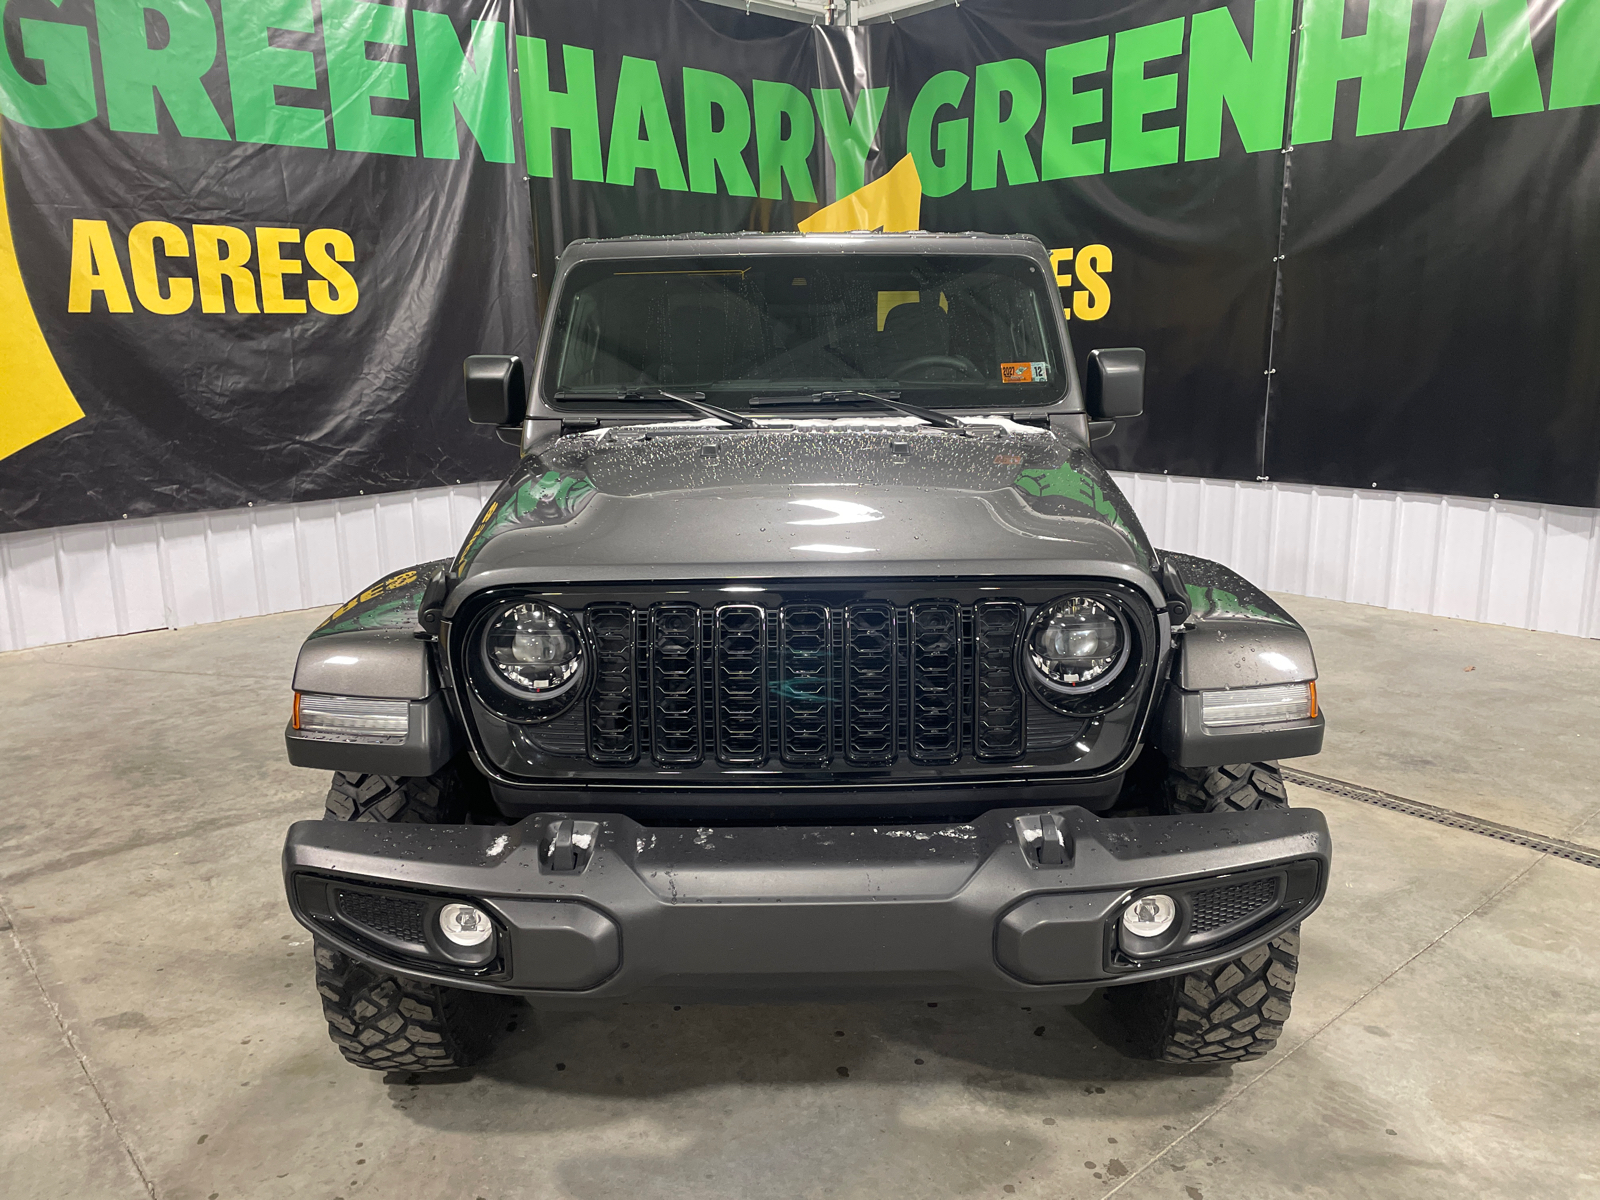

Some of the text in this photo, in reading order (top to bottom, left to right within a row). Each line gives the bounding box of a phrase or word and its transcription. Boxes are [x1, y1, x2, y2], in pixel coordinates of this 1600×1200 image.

[0, 0, 516, 163] GREEN
[516, 0, 1293, 203] HARRY GREEN
[1291, 0, 1600, 145] HA
[67, 218, 360, 315] ACRES
[1003, 366, 1043, 377] 2027 12
